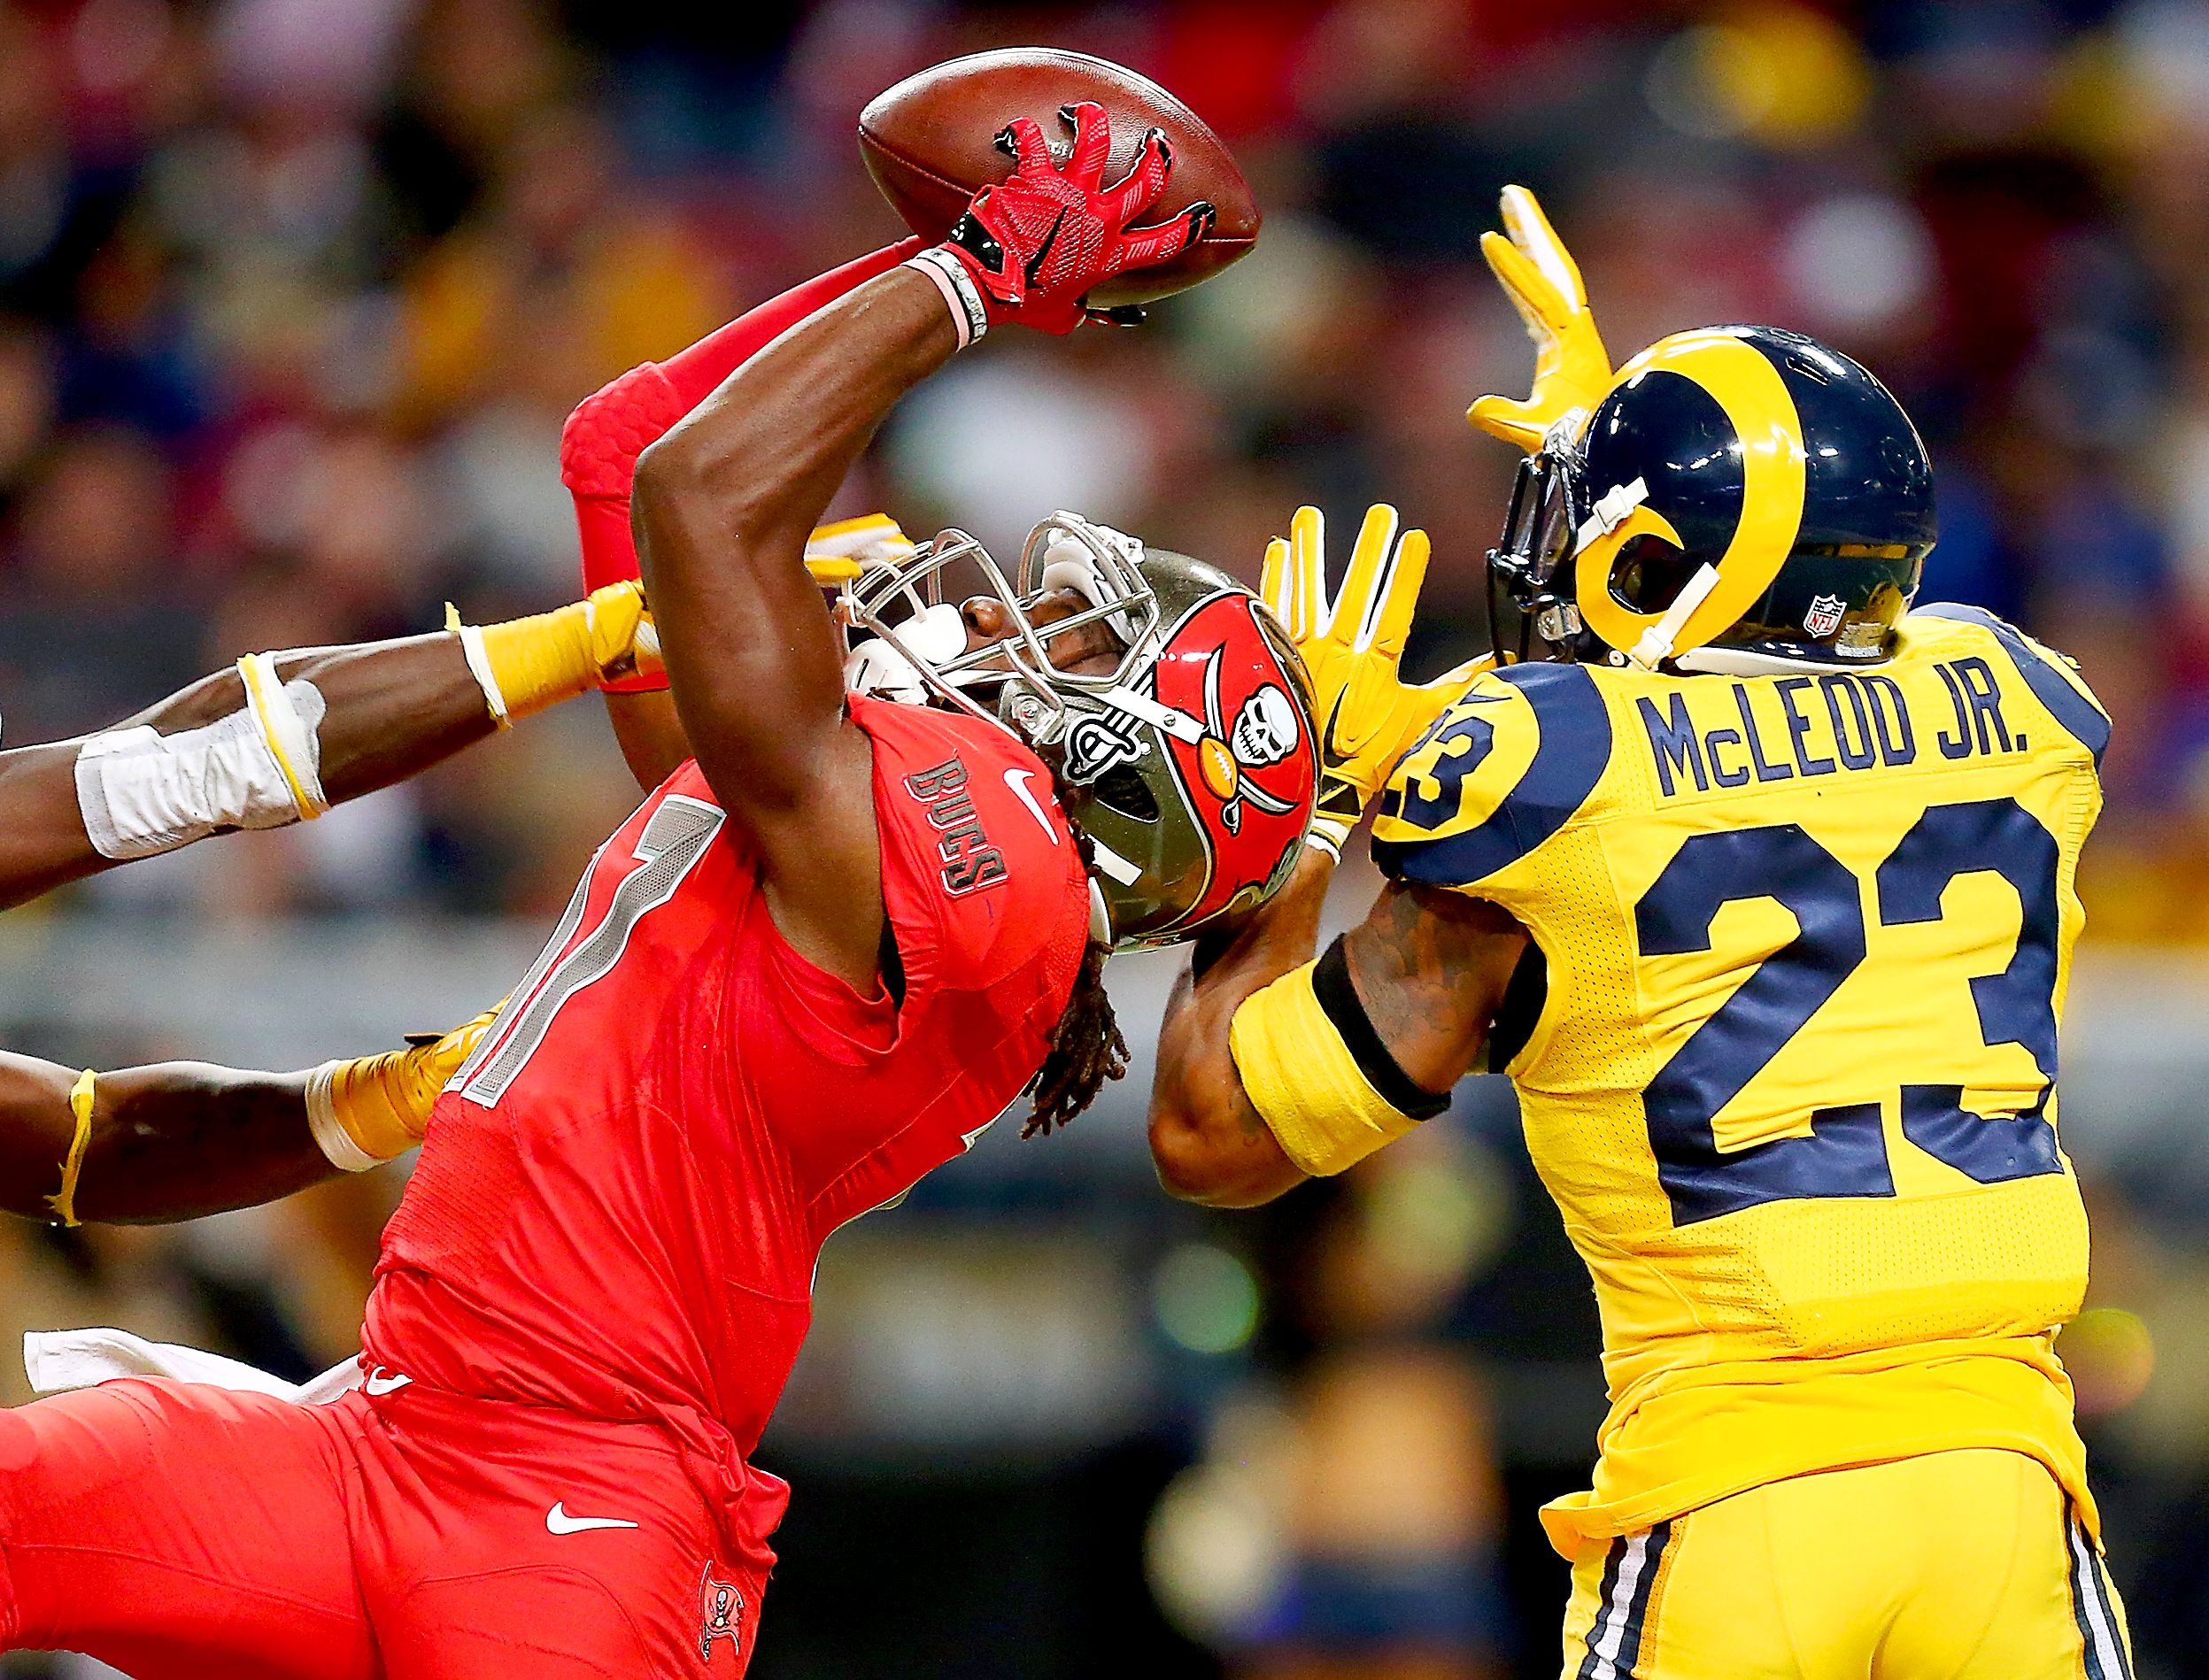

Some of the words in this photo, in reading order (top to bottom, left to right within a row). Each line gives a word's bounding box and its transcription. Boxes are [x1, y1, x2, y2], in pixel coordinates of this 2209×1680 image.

[1807, 612, 1834, 631] NFL
[1637, 674, 1916, 797] McLEOD
[1933, 657, 2027, 759] JR.
[903, 755, 1009, 896] BUCS
[1634, 797, 2065, 1228] 23
